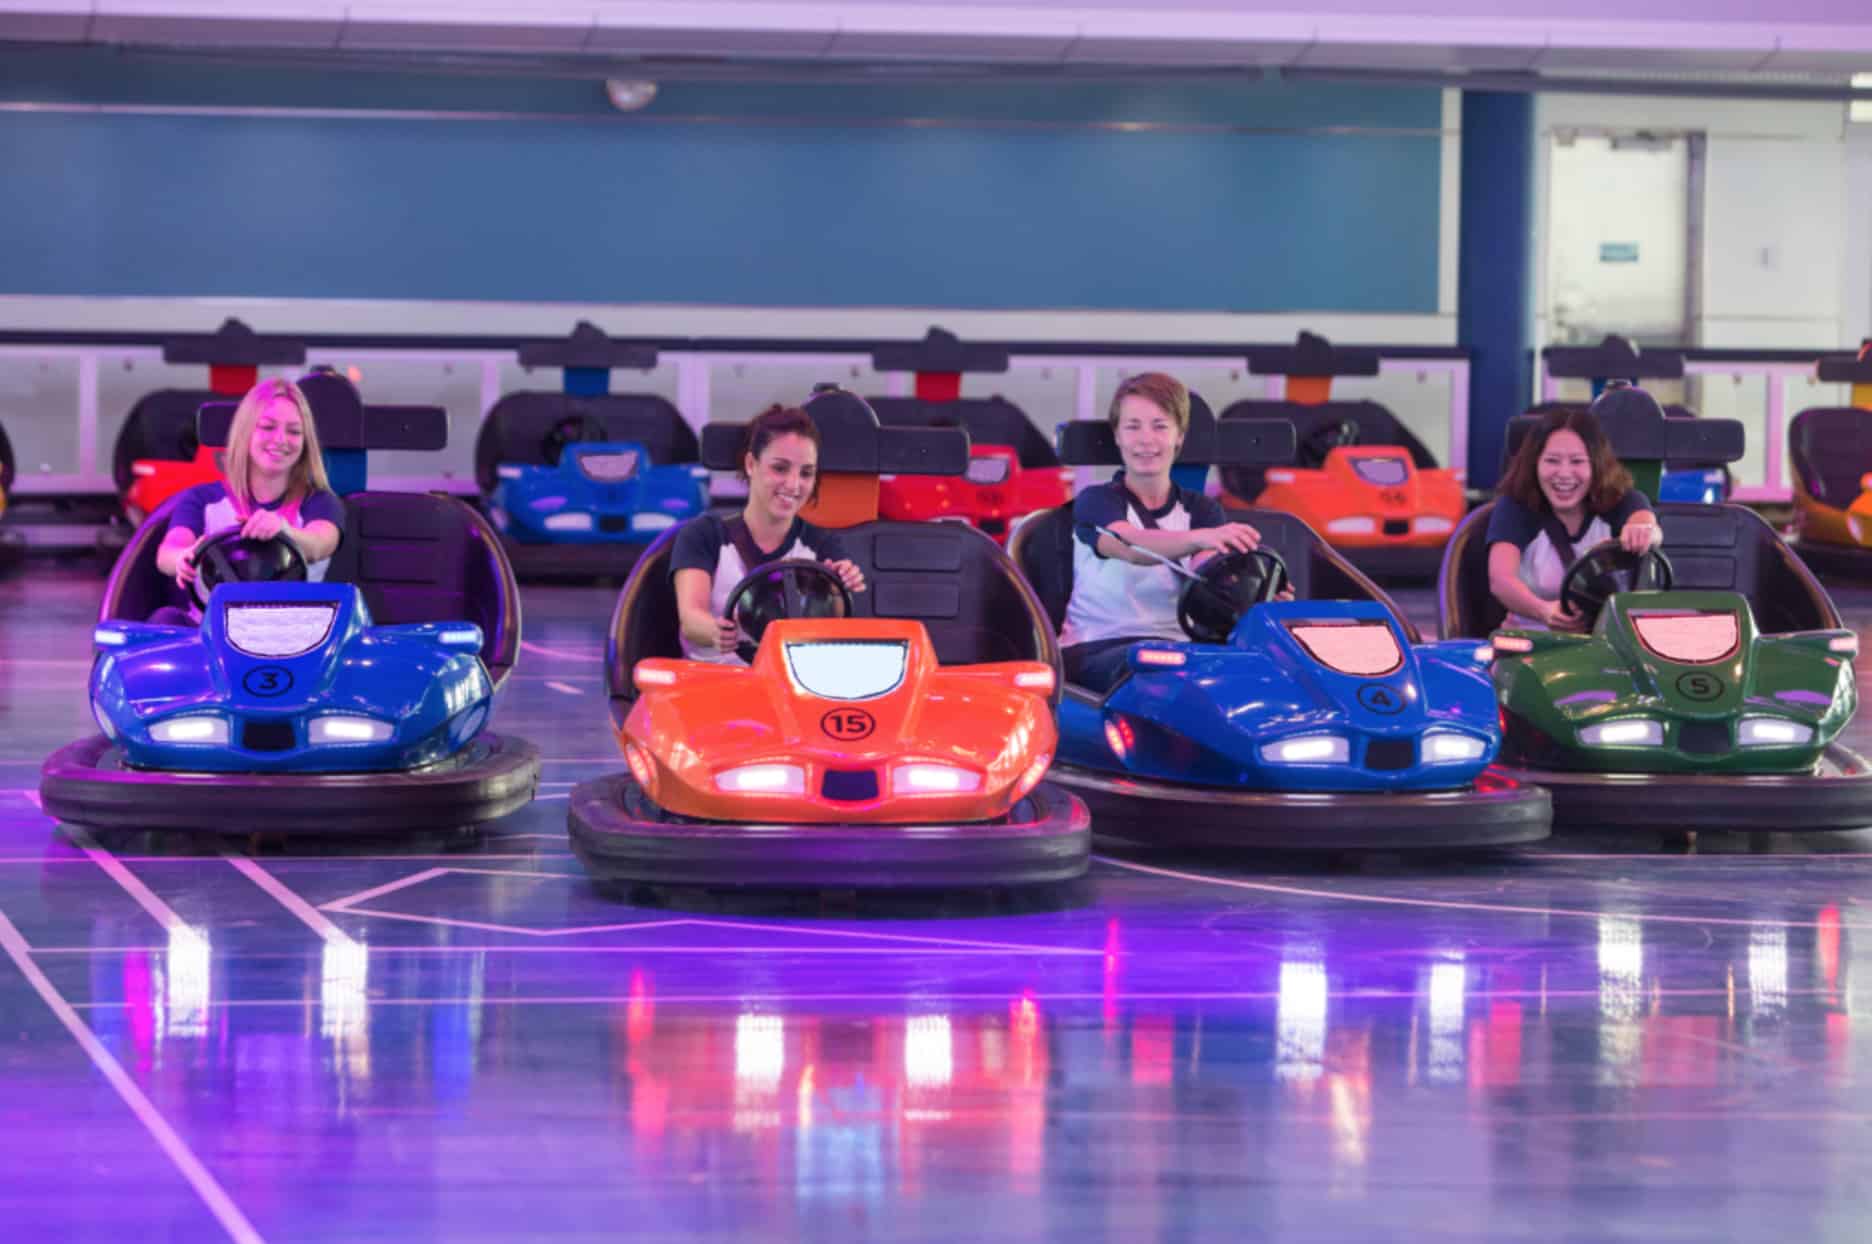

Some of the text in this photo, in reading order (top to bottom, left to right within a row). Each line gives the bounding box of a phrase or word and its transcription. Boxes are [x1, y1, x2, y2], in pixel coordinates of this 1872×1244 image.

[258, 672, 278, 690] 3
[1690, 678, 1710, 694] 5
[1372, 690, 1391, 706] 4
[830, 716, 867, 734] 15
